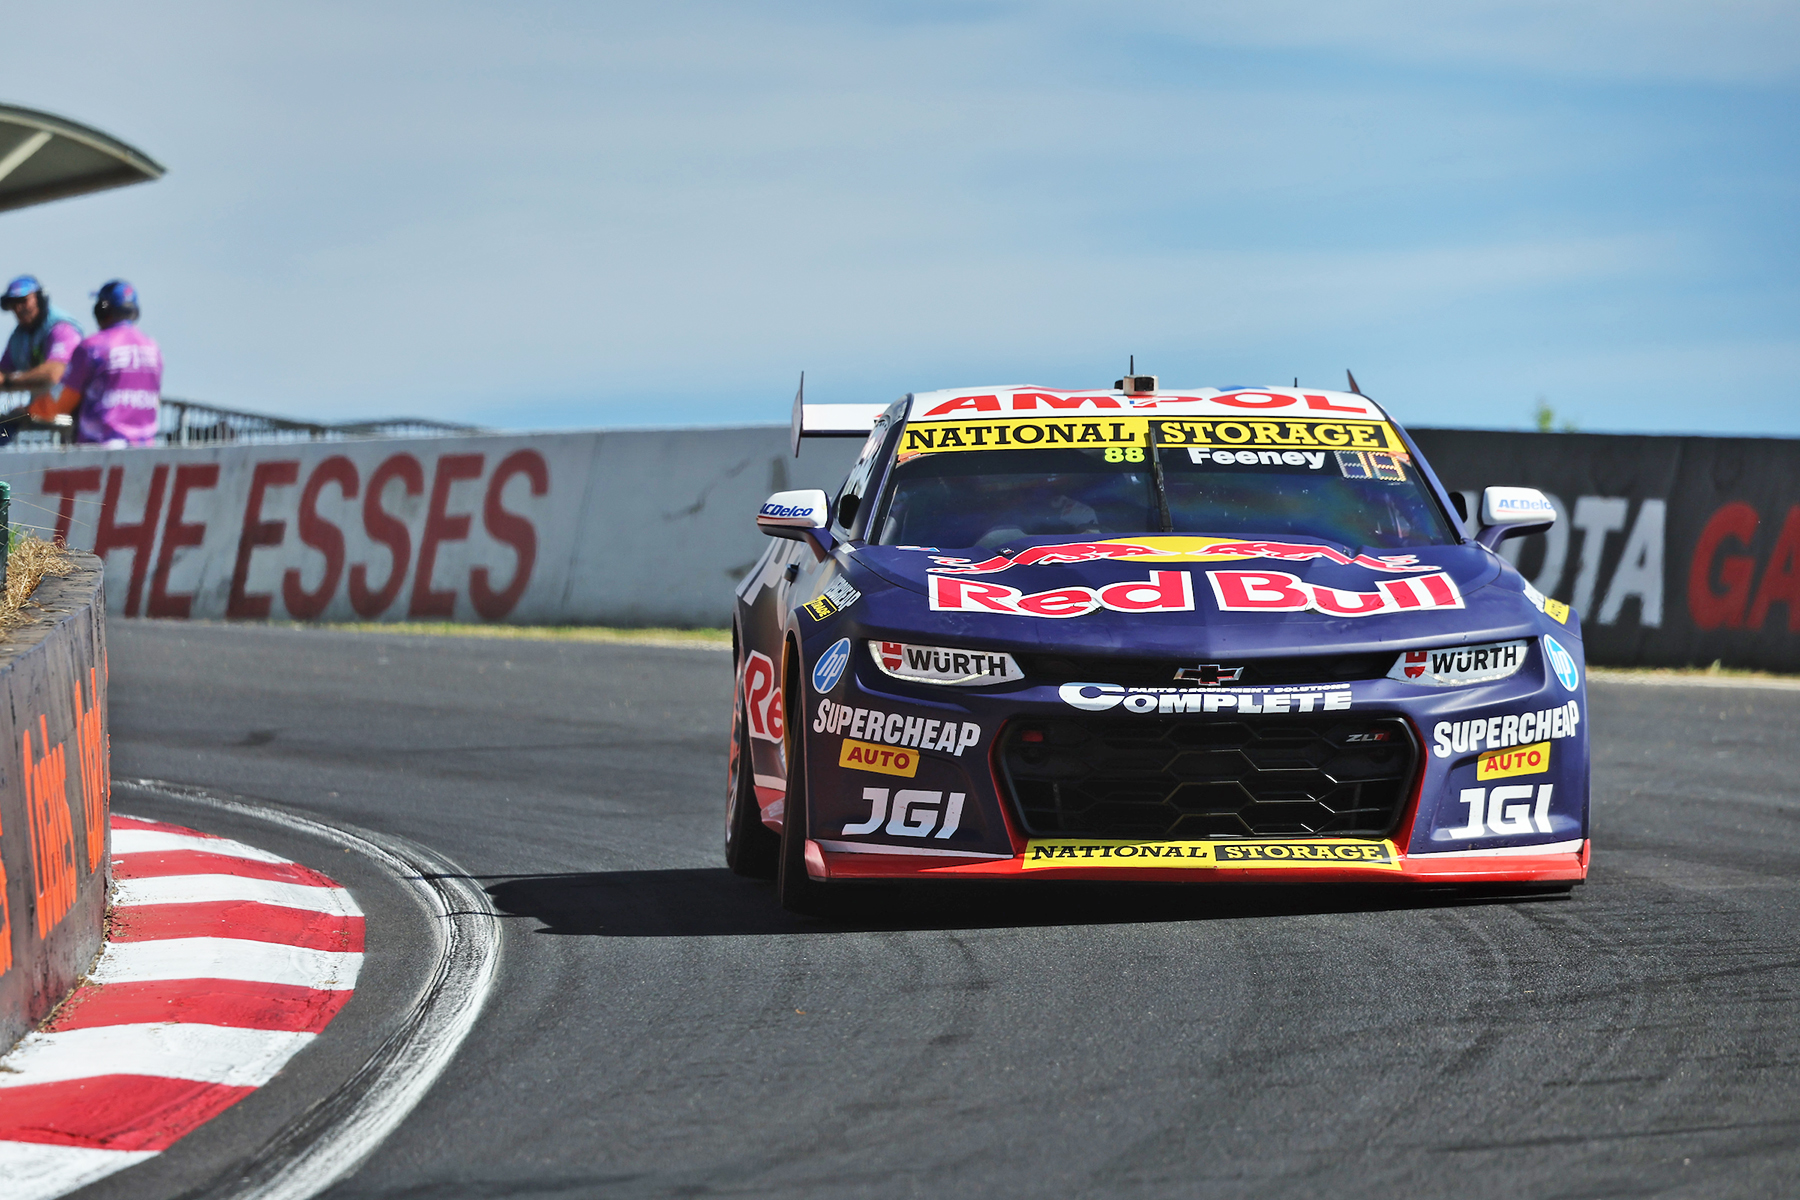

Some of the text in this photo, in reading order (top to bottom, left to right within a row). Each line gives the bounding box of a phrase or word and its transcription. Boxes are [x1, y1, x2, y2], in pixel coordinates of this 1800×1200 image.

[923, 391, 1368, 417] AMPOL
[905, 422, 1135, 450] NATIONAL
[1160, 421, 1380, 448] STORAGE
[1104, 447, 1146, 463] 88
[1187, 447, 1326, 470] Feeney
[42, 447, 549, 621] THE ESSES
[928, 570, 1196, 618] Red
[1206, 570, 1466, 618] Bull
[815, 640, 848, 692] hp
[907, 648, 1007, 677] WÜRTH
[1431, 645, 1518, 674] WÜRTH
[1058, 682, 1353, 714] COMPLETE
[812, 698, 982, 757] SUPERCHEAP
[1433, 699, 1580, 759] SUPERCHEAP
[846, 746, 911, 770] AUTO
[1484, 750, 1541, 773] AUTO
[841, 786, 966, 840] JGI
[1448, 783, 1554, 840] JGI
[1031, 844, 1383, 861] NATIONAL STORAGE
